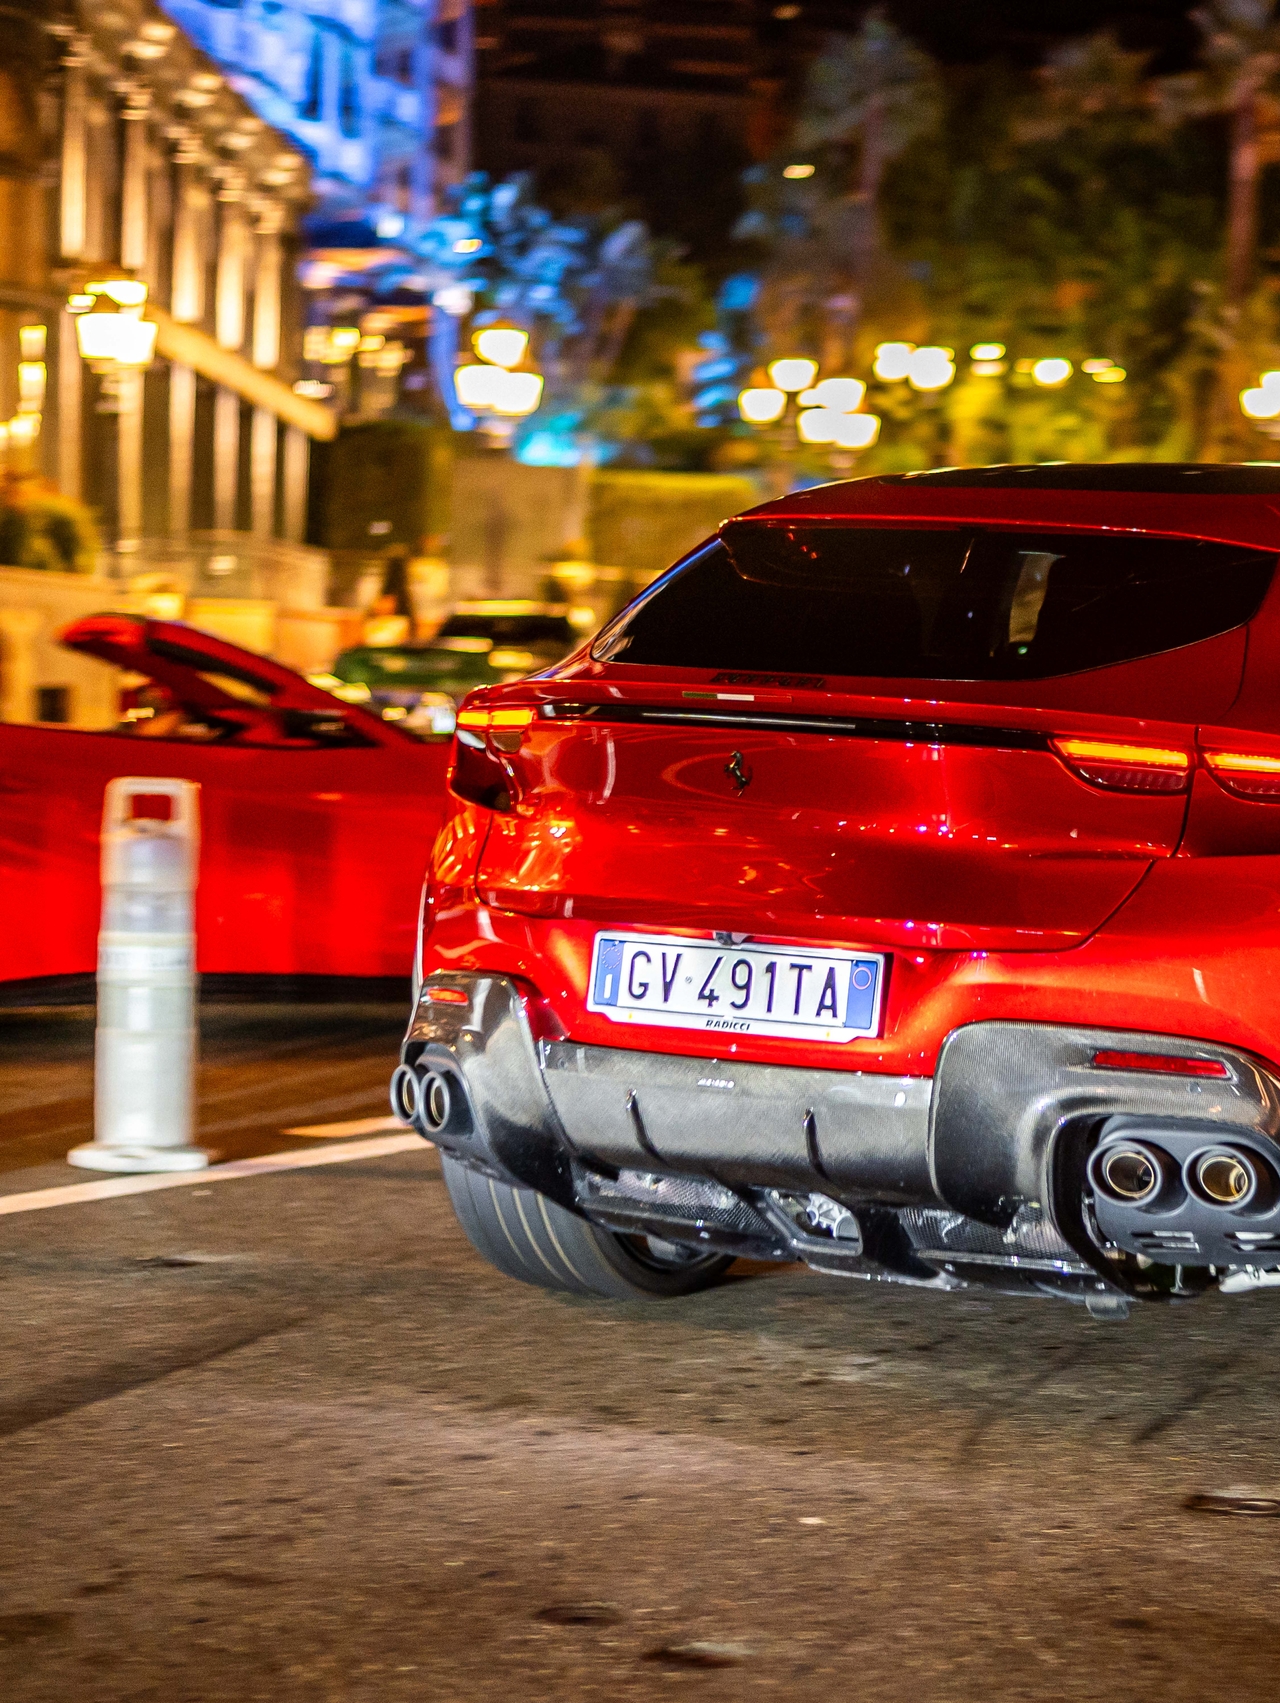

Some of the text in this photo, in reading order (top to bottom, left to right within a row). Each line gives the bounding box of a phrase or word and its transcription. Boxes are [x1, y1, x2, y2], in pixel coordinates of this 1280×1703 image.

[628, 950, 838, 1018] GV 491TA
[705, 1019, 751, 1031] RADICCI
